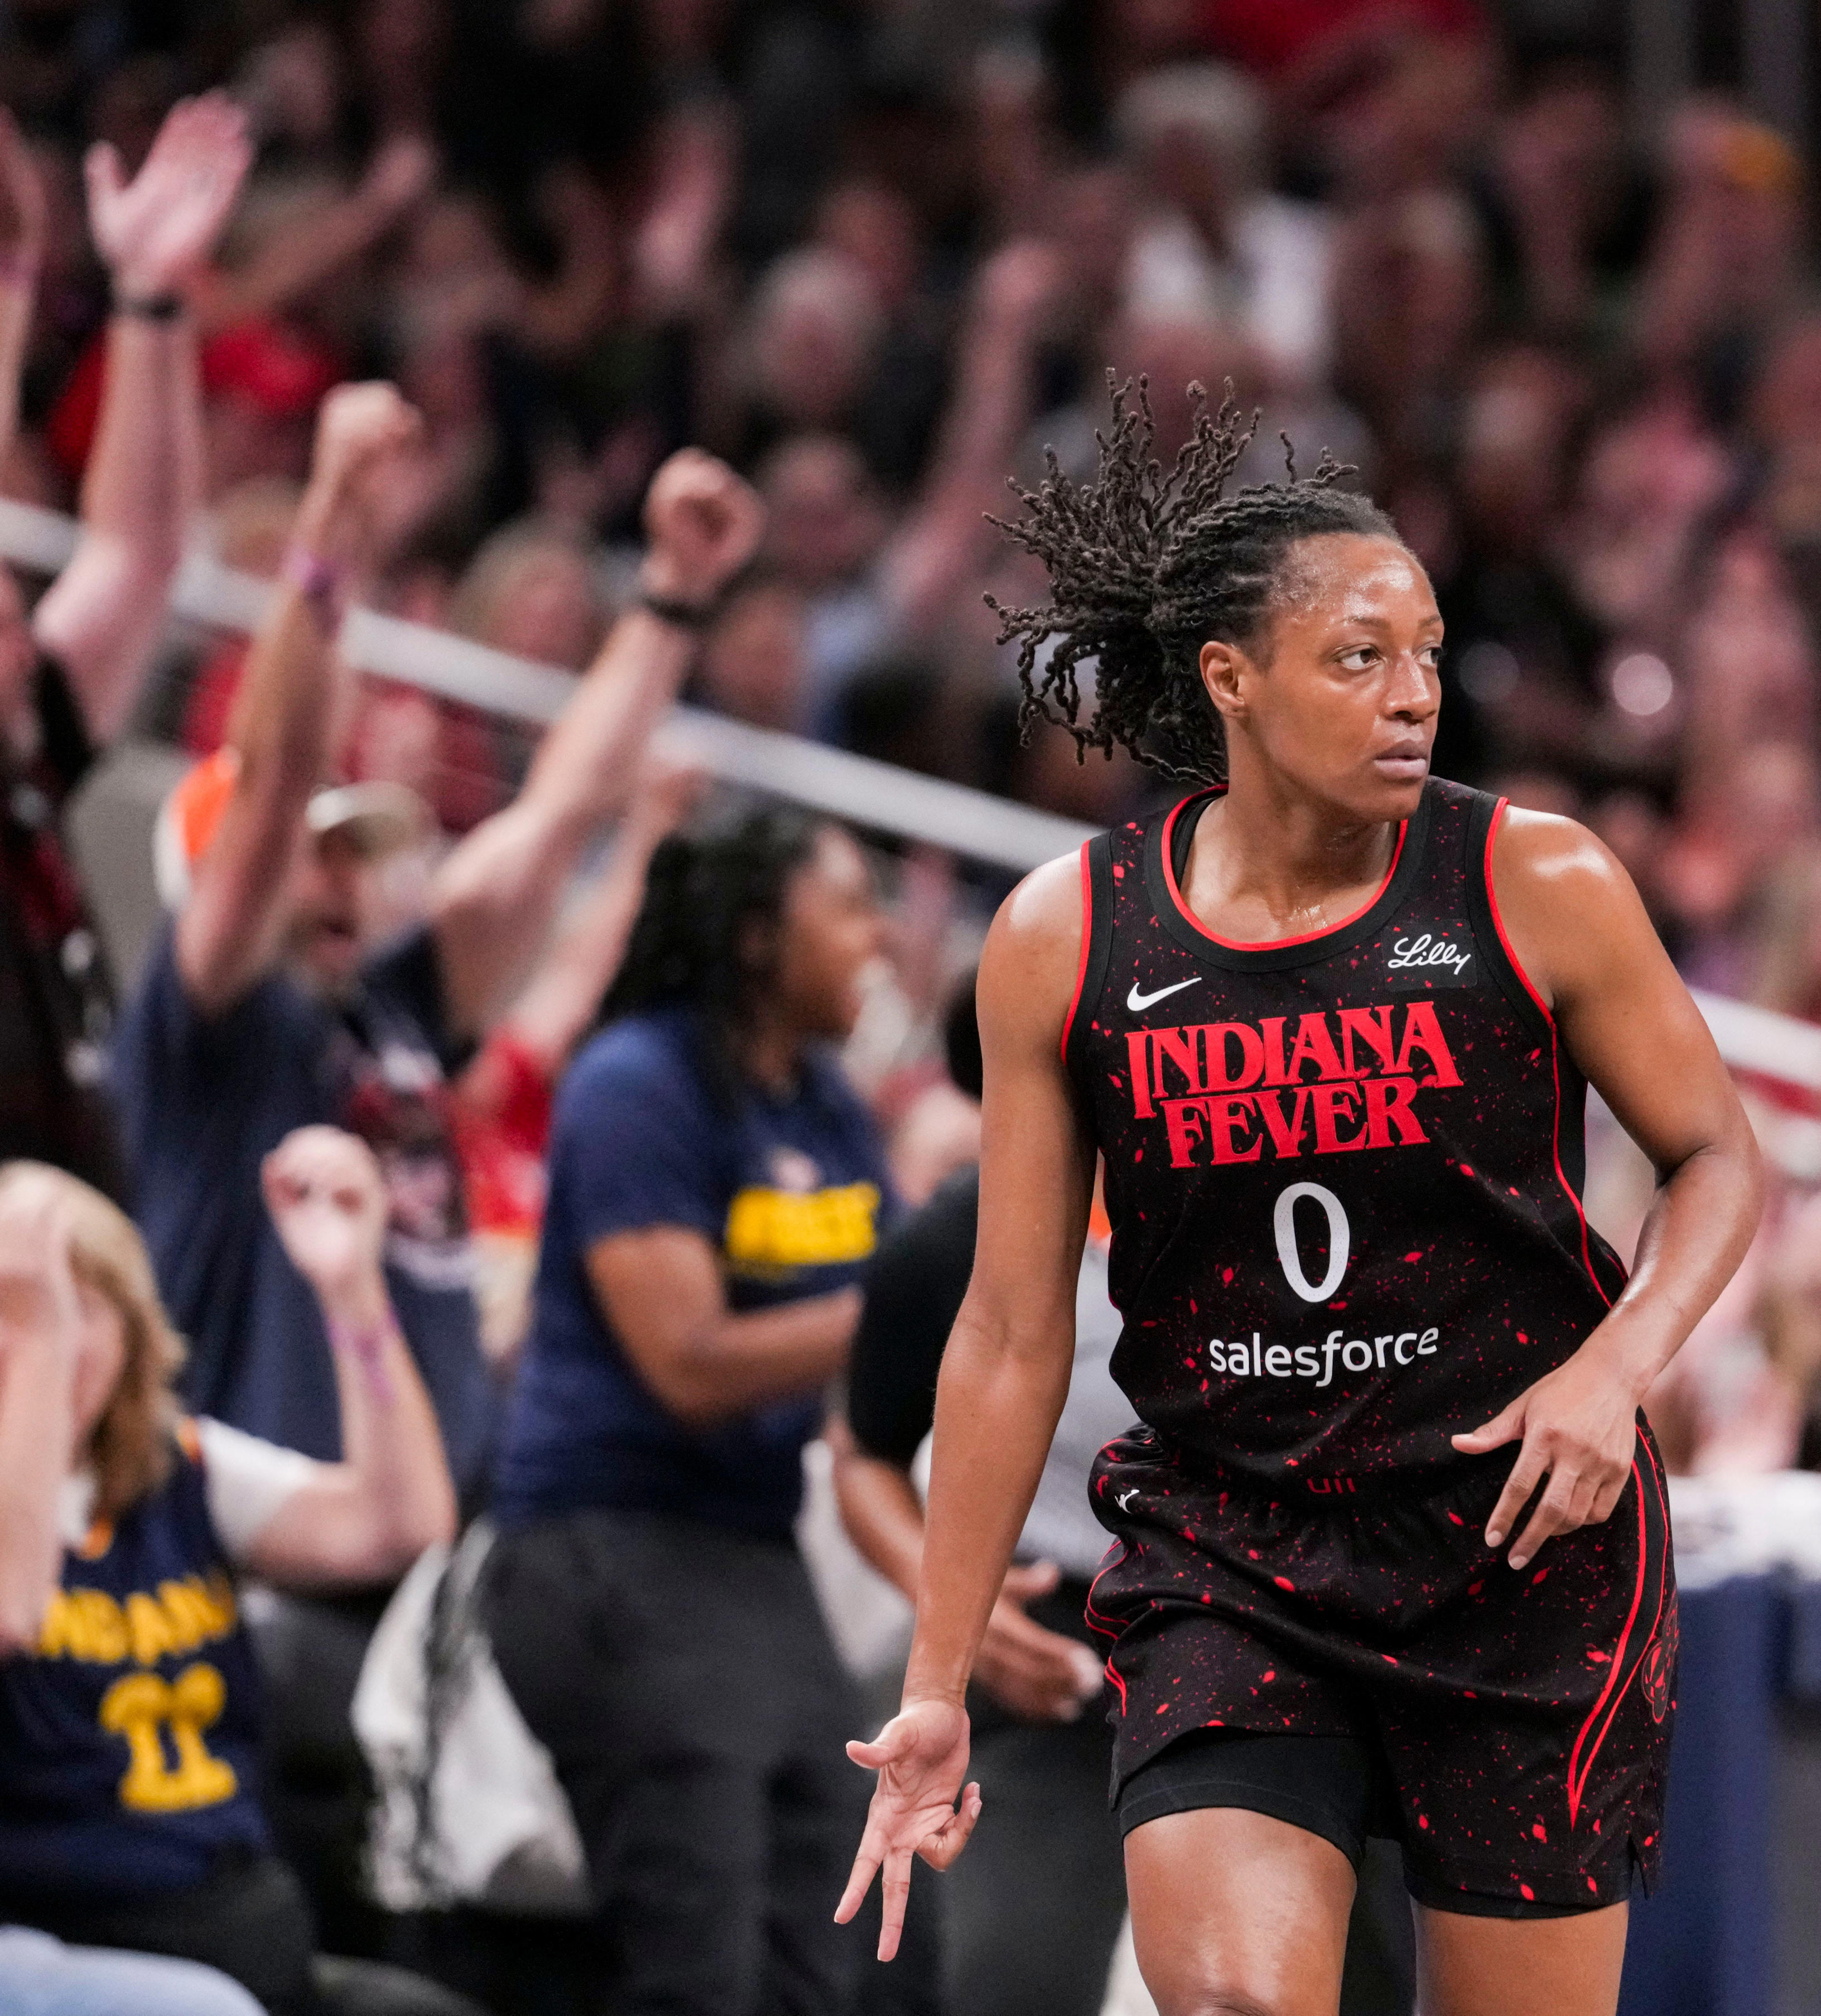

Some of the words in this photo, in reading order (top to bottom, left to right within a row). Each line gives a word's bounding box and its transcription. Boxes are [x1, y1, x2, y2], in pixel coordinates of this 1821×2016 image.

[1388, 933, 1471, 976] Lilly
[1124, 1000, 1464, 1120] INDIANA
[1160, 1077, 1431, 1169] FEVER
[1274, 1181, 1350, 1303] 0
[1208, 1327, 1439, 1387] salesforce
